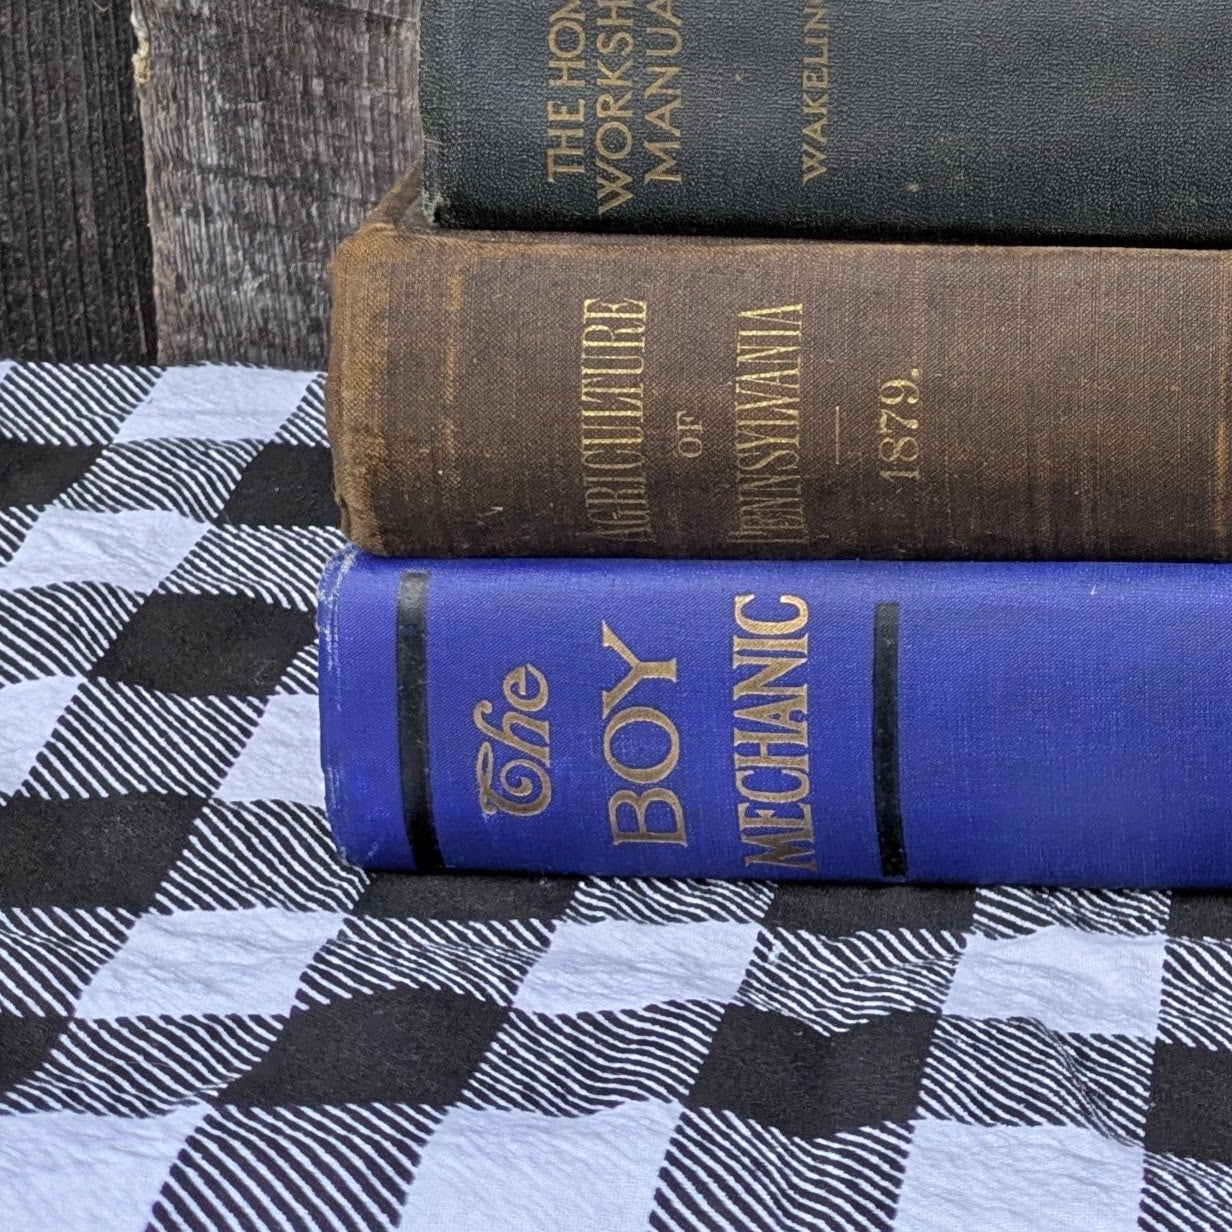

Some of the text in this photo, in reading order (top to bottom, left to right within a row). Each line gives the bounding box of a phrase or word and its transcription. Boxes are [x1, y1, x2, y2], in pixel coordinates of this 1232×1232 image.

[547, 99, 585, 183] THE
[578, 298, 655, 543] AGRICULTURE
[677, 410, 703, 458] OF
[727, 303, 807, 544] PENNSYLVANIA
[879, 368, 920, 481] 1879.
[473, 663, 552, 816] The
[602, 620, 688, 848] BOY
[733, 594, 817, 873] MECHANIC
